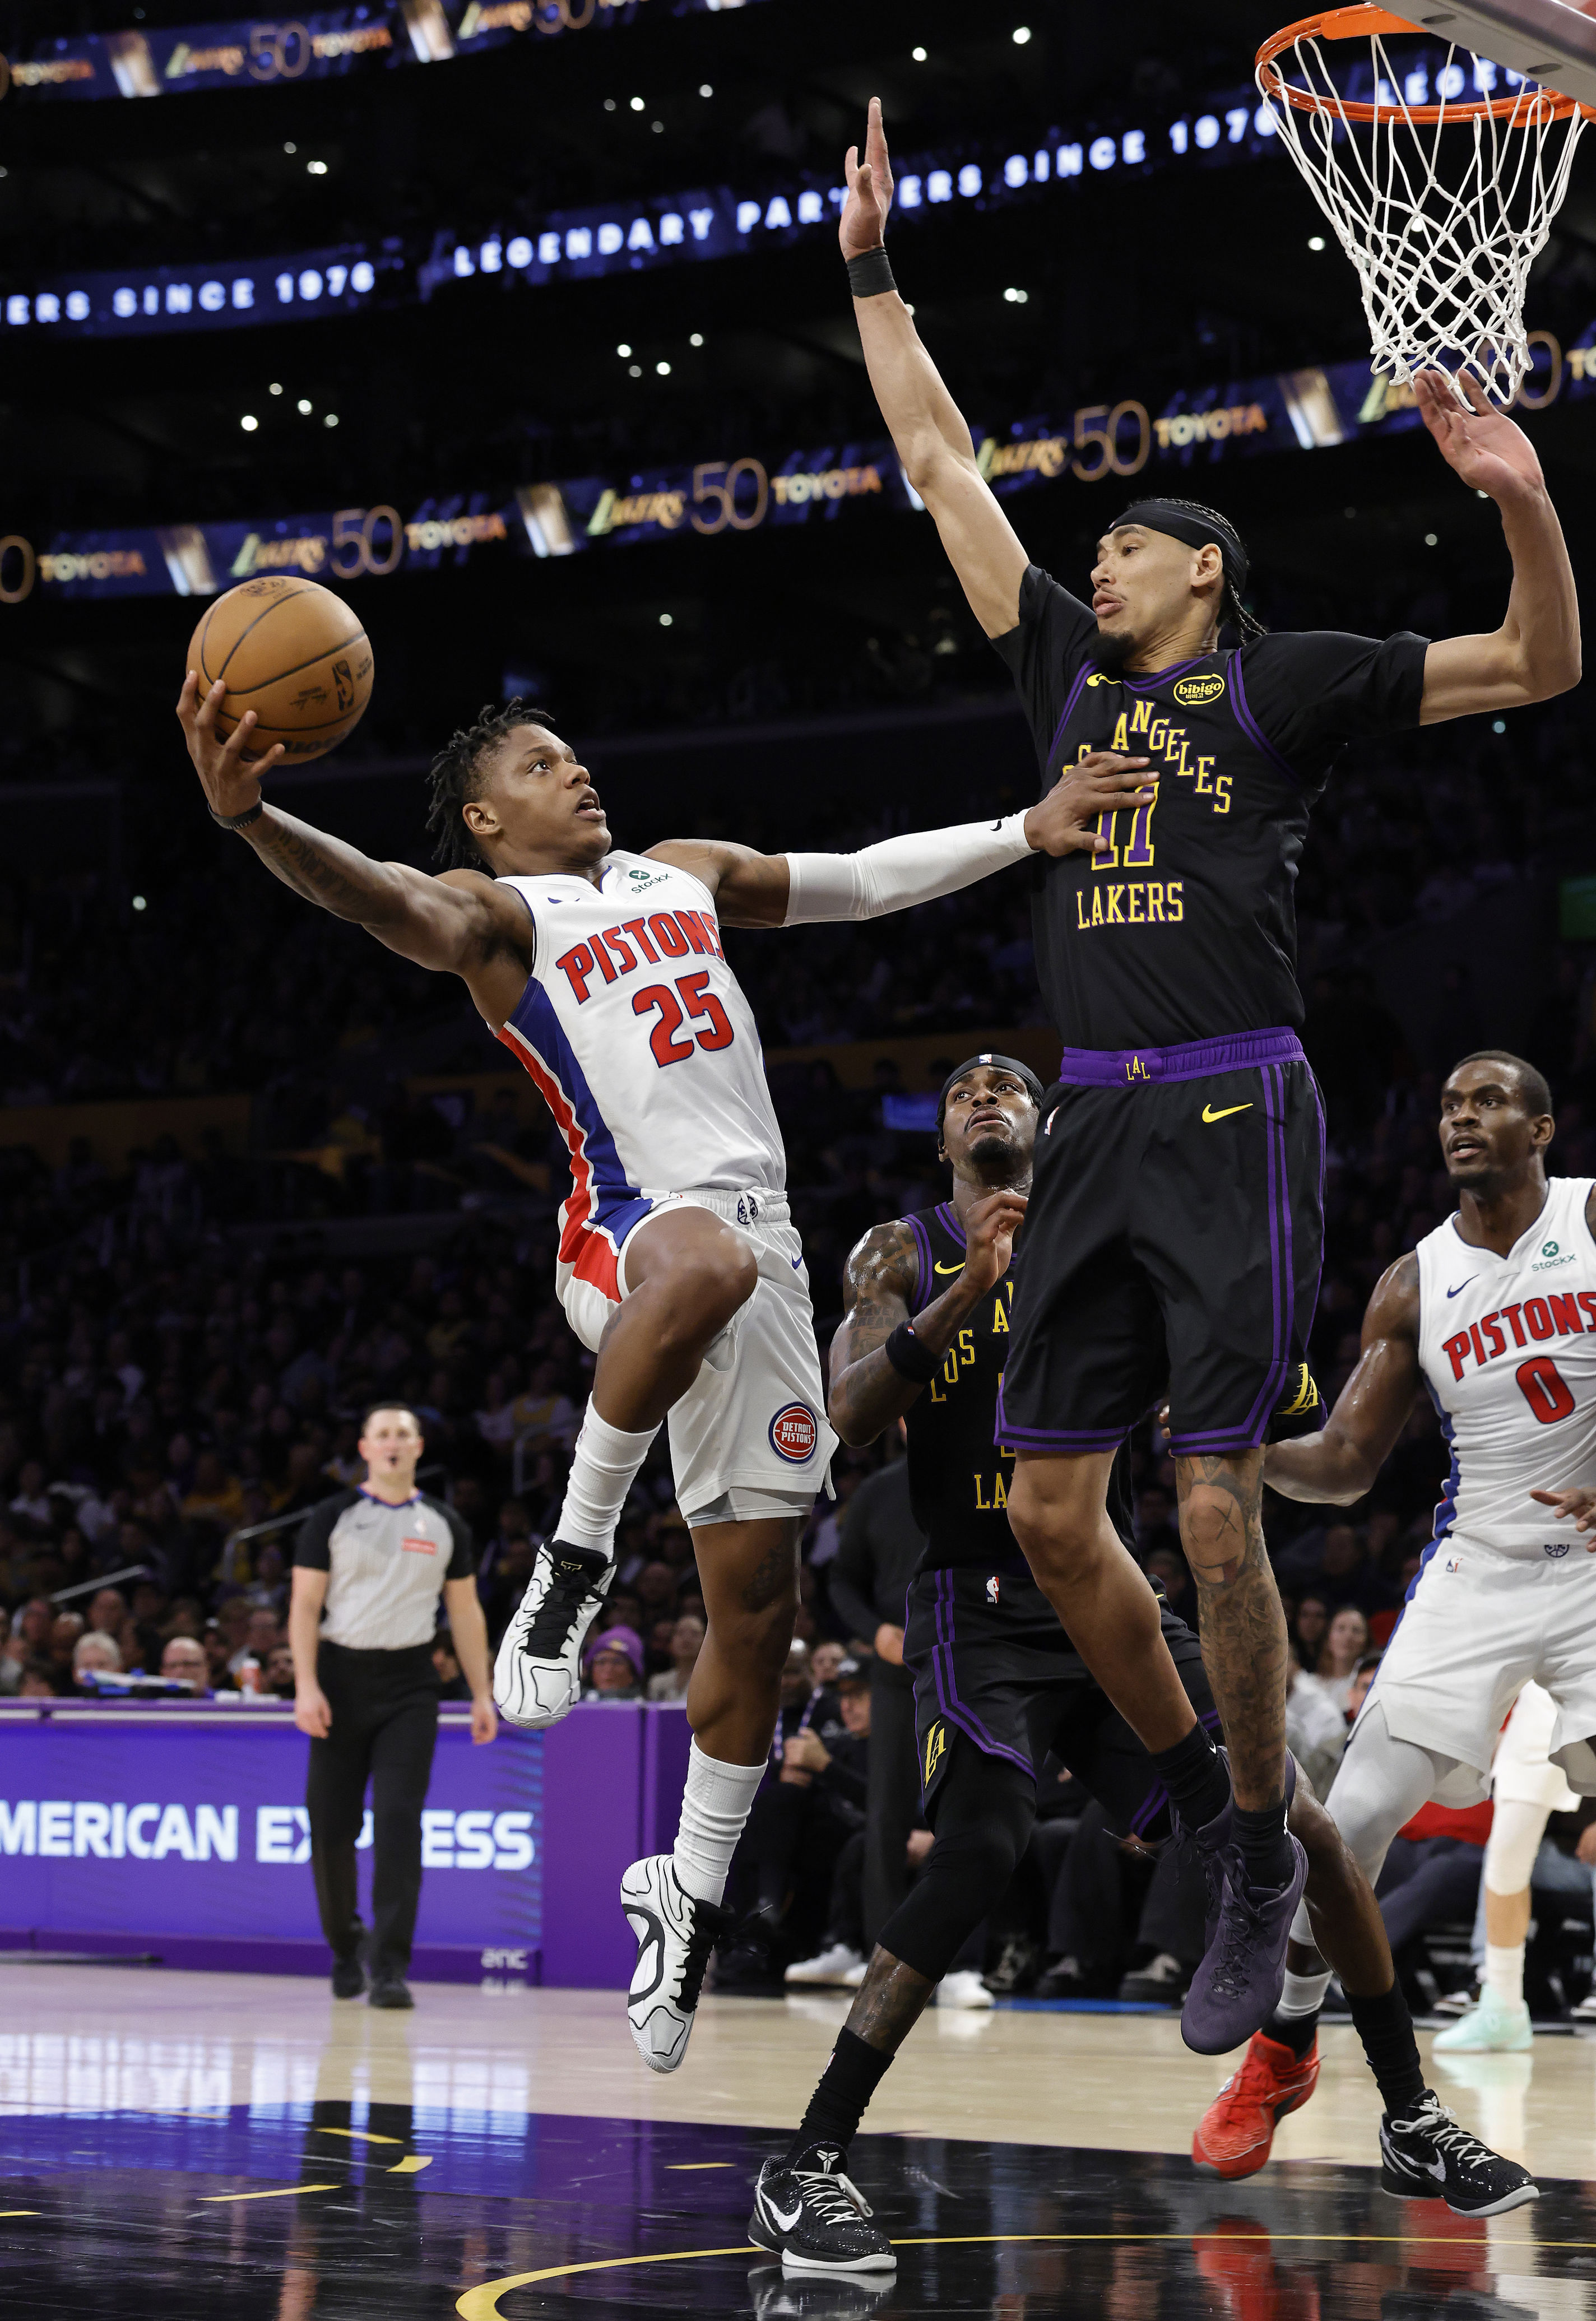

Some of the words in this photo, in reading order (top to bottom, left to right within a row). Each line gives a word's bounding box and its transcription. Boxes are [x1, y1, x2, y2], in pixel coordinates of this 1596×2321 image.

[454, 207, 713, 277] LEGENDARY
[737, 164, 982, 233] PARERS
[1004, 129, 1145, 188] SINCE
[0, 291, 90, 325] ERS
[113, 277, 254, 318] SINCE
[1071, 399, 1150, 481] 50
[1154, 403, 1267, 447] TOYOTA
[690, 457, 768, 535] 50
[771, 466, 881, 505] TOYOTA
[331, 505, 402, 579] 50
[1179, 682, 1222, 695] bibigo
[1110, 700, 1234, 814] ANGELES
[1076, 881, 1185, 930] LAKERS
[555, 910, 725, 1005] PISTONS
[632, 971, 734, 1068] 25
[1125, 1055, 1150, 1080] LAL
[1442, 1292, 1596, 1383] PISTONS
[1516, 1356, 1575, 1424] 0
[781, 1431, 811, 1444] PISTONS
[782, 1422, 811, 1434] DETROIT
[0, 1799, 239, 1862] MERICAN
[256, 1805, 536, 1871] EXESS
